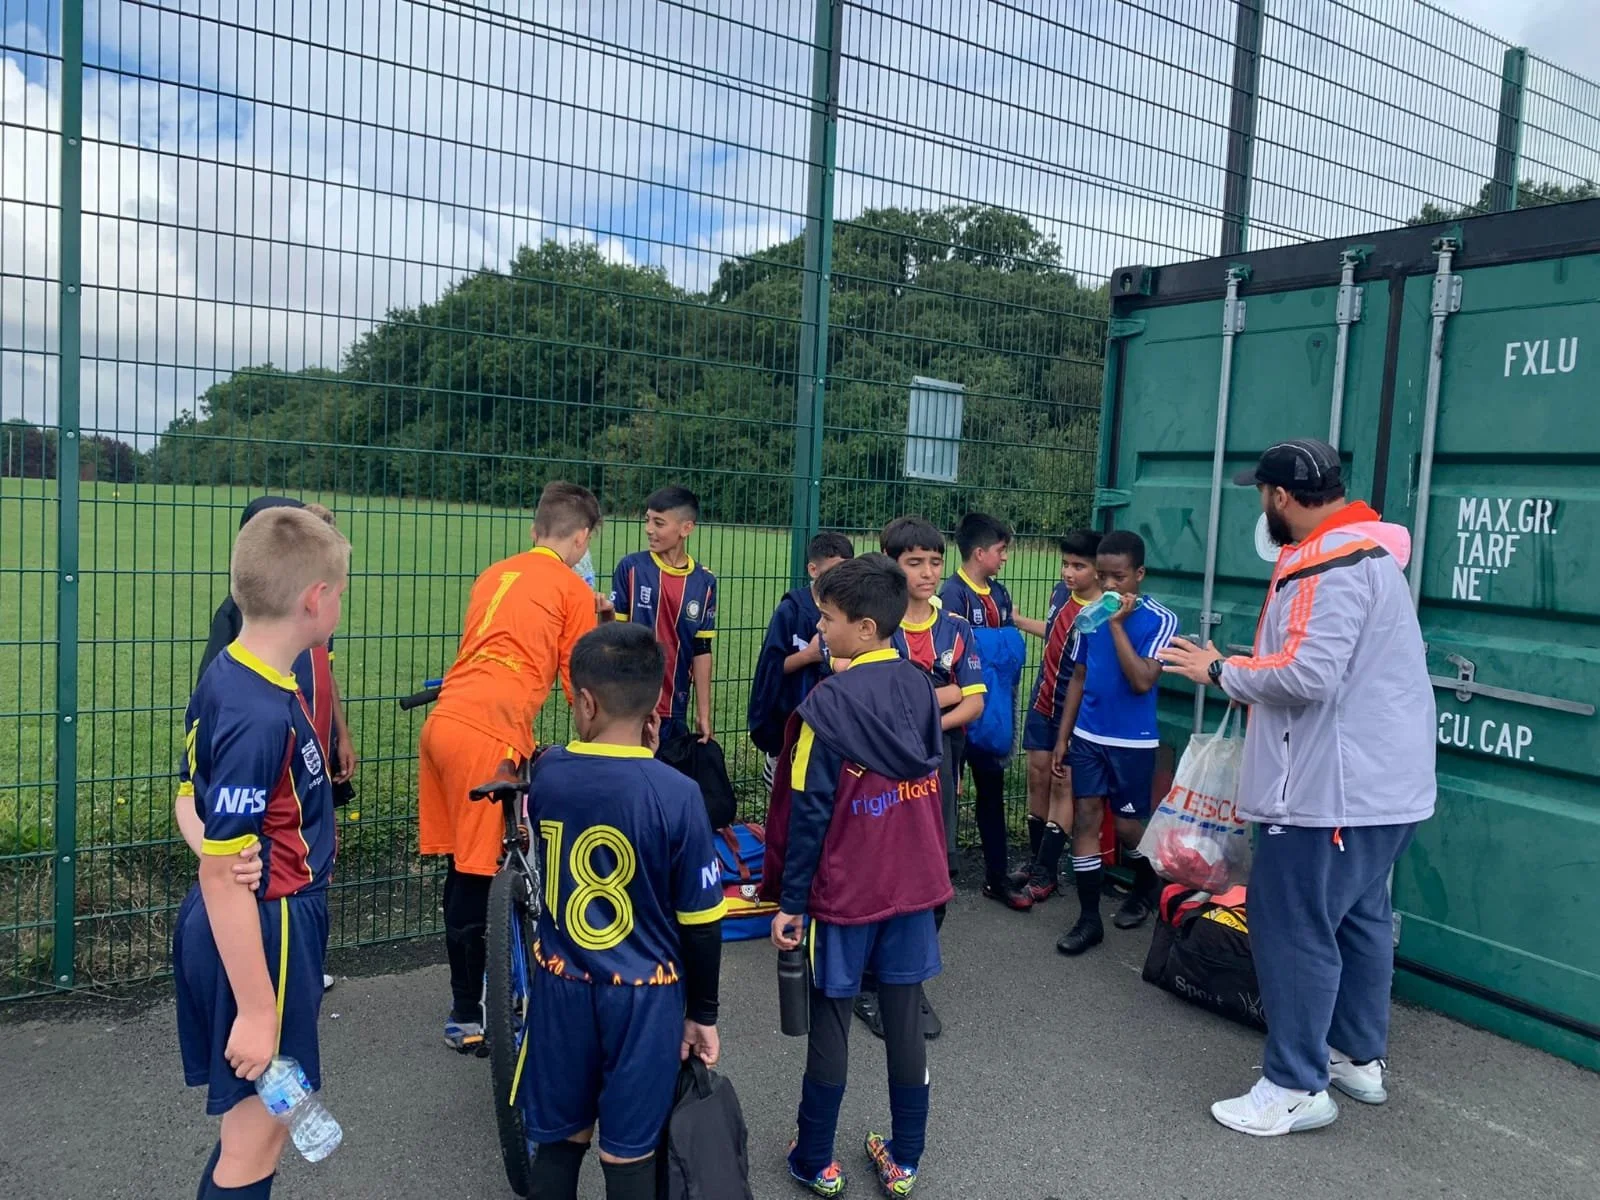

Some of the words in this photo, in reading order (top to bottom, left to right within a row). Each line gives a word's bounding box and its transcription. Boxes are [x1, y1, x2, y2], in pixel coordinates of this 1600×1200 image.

[1504, 337, 1578, 377] FXLU
[1457, 497, 1557, 535] MAX.GR.
[476, 571, 522, 637] 1
[214, 787, 267, 814] NHS
[540, 820, 636, 951] 18
